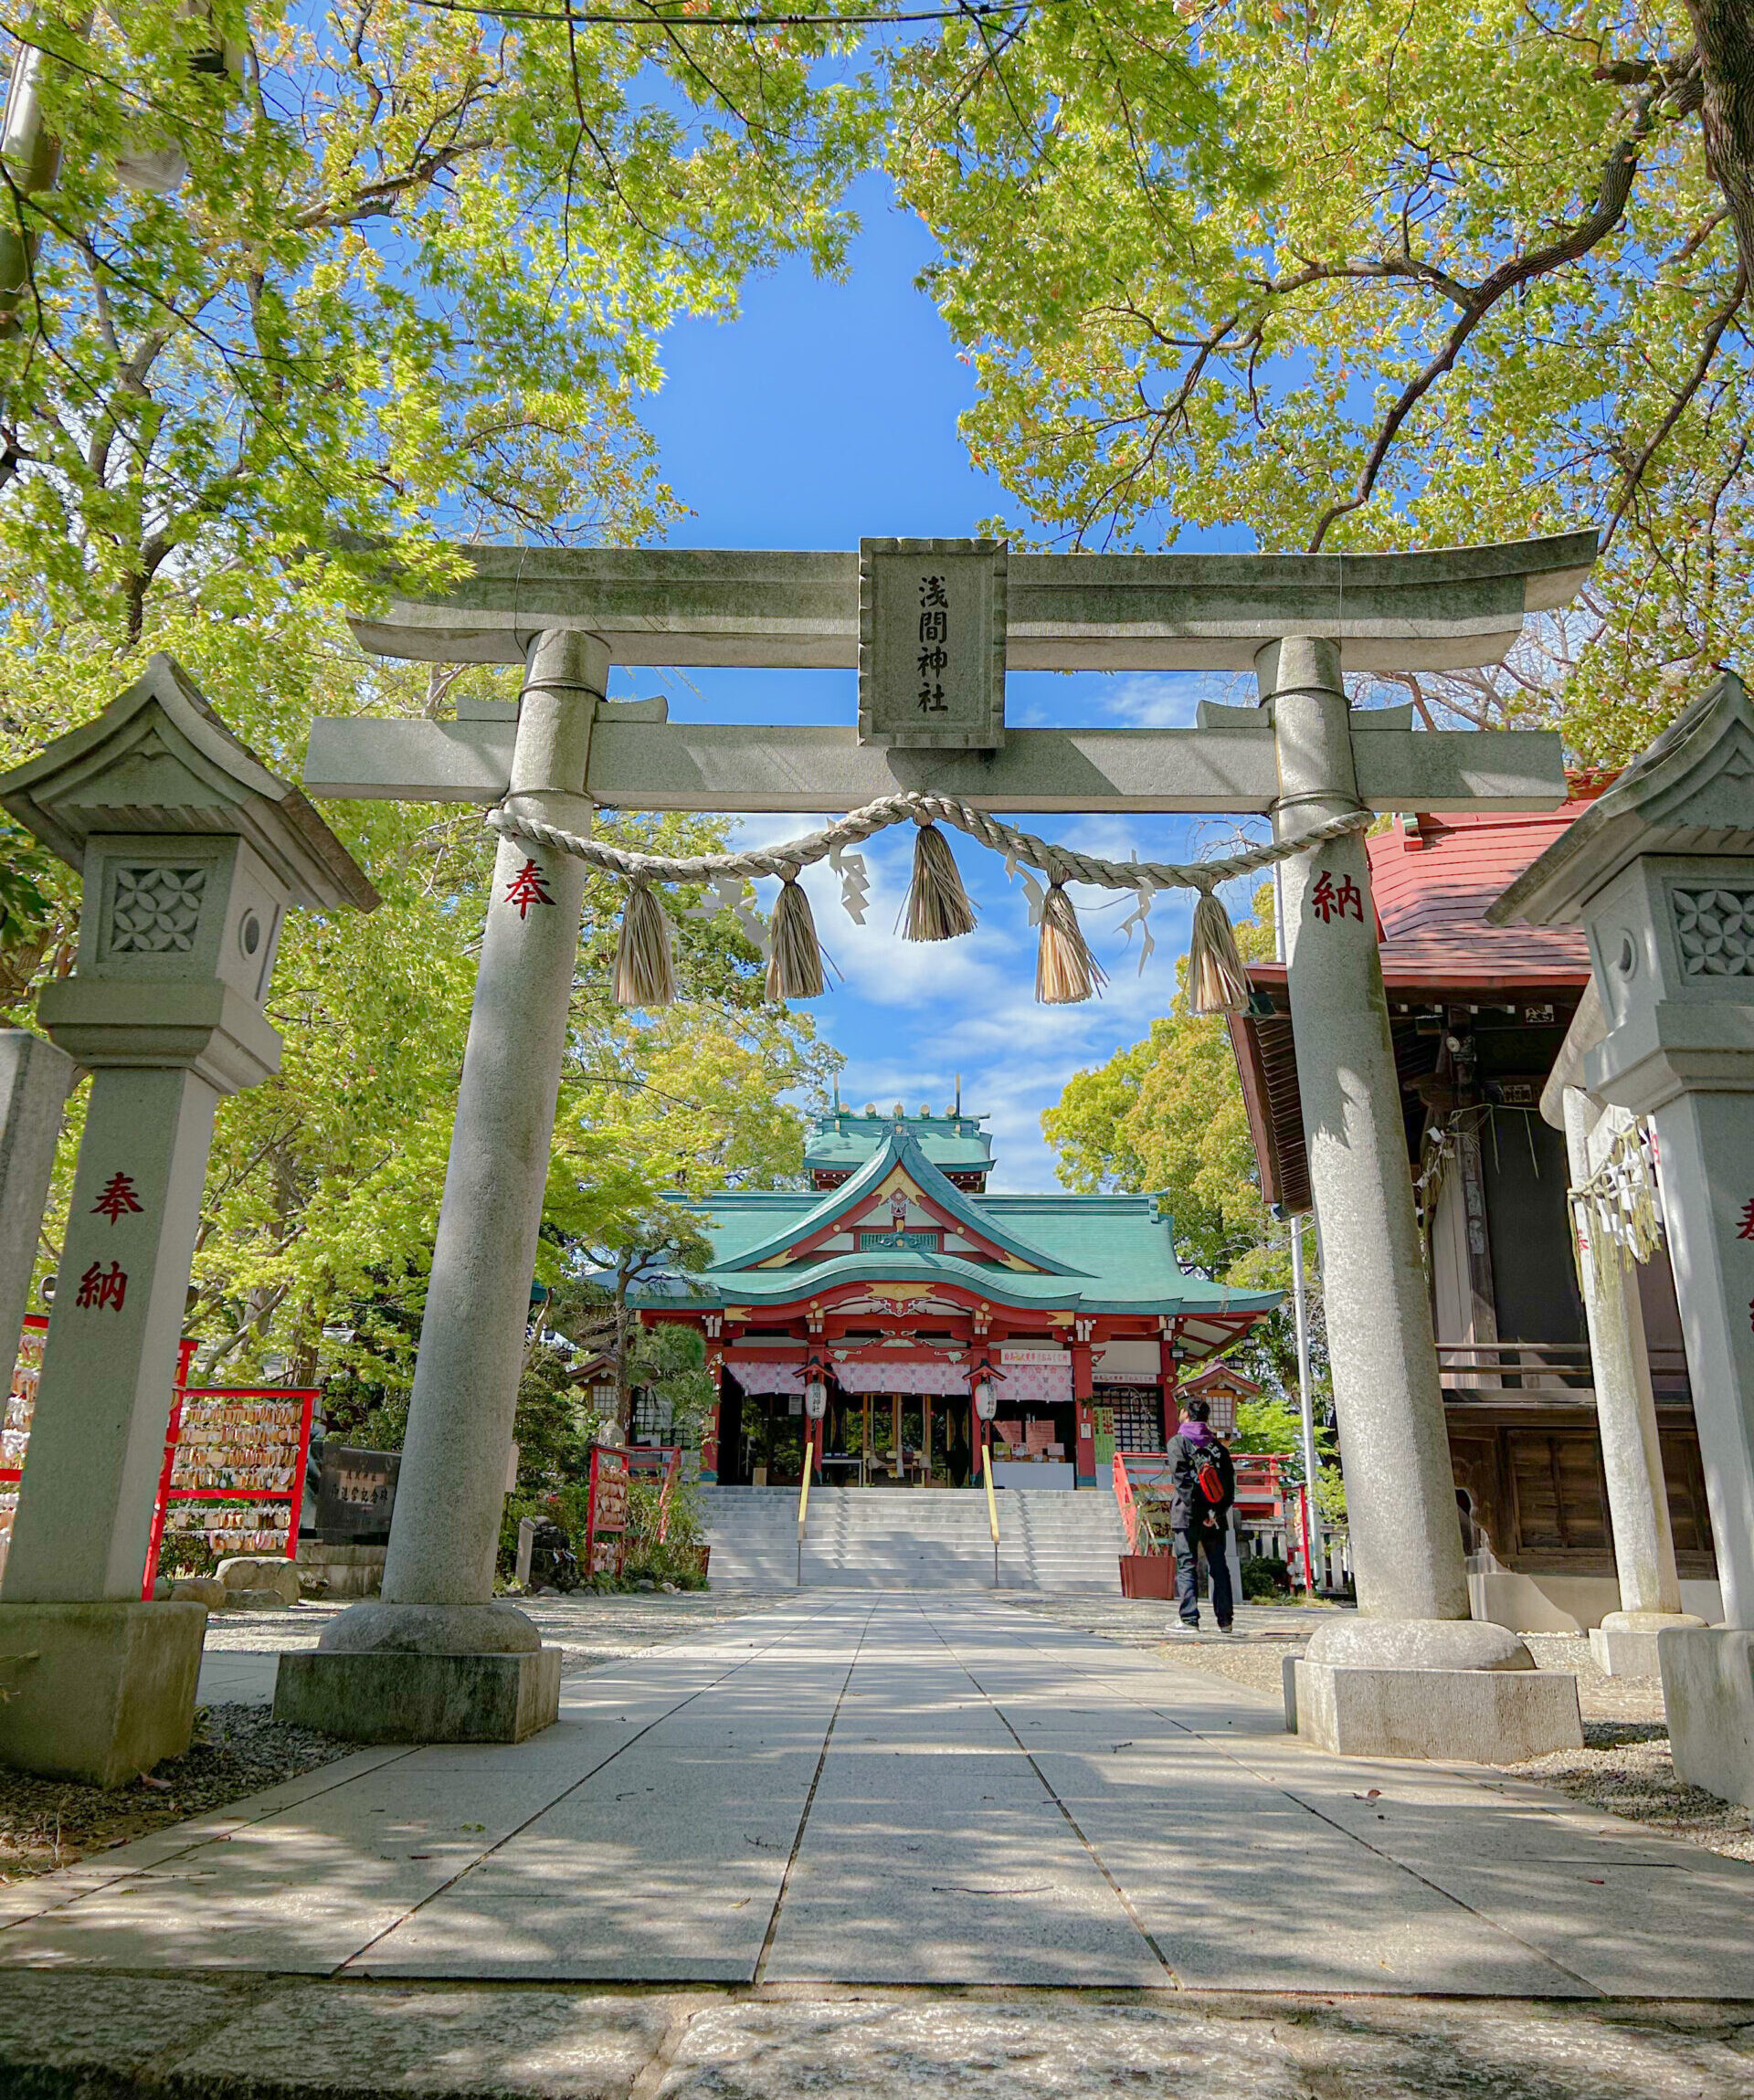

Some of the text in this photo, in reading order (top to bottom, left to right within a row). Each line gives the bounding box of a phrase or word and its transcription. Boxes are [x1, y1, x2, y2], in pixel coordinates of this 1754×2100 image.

[917, 575, 949, 713] 浅間神社
[503, 859, 557, 921] 奉
[1312, 871, 1364, 924] 納
[76, 1171, 144, 1312] 奉納
